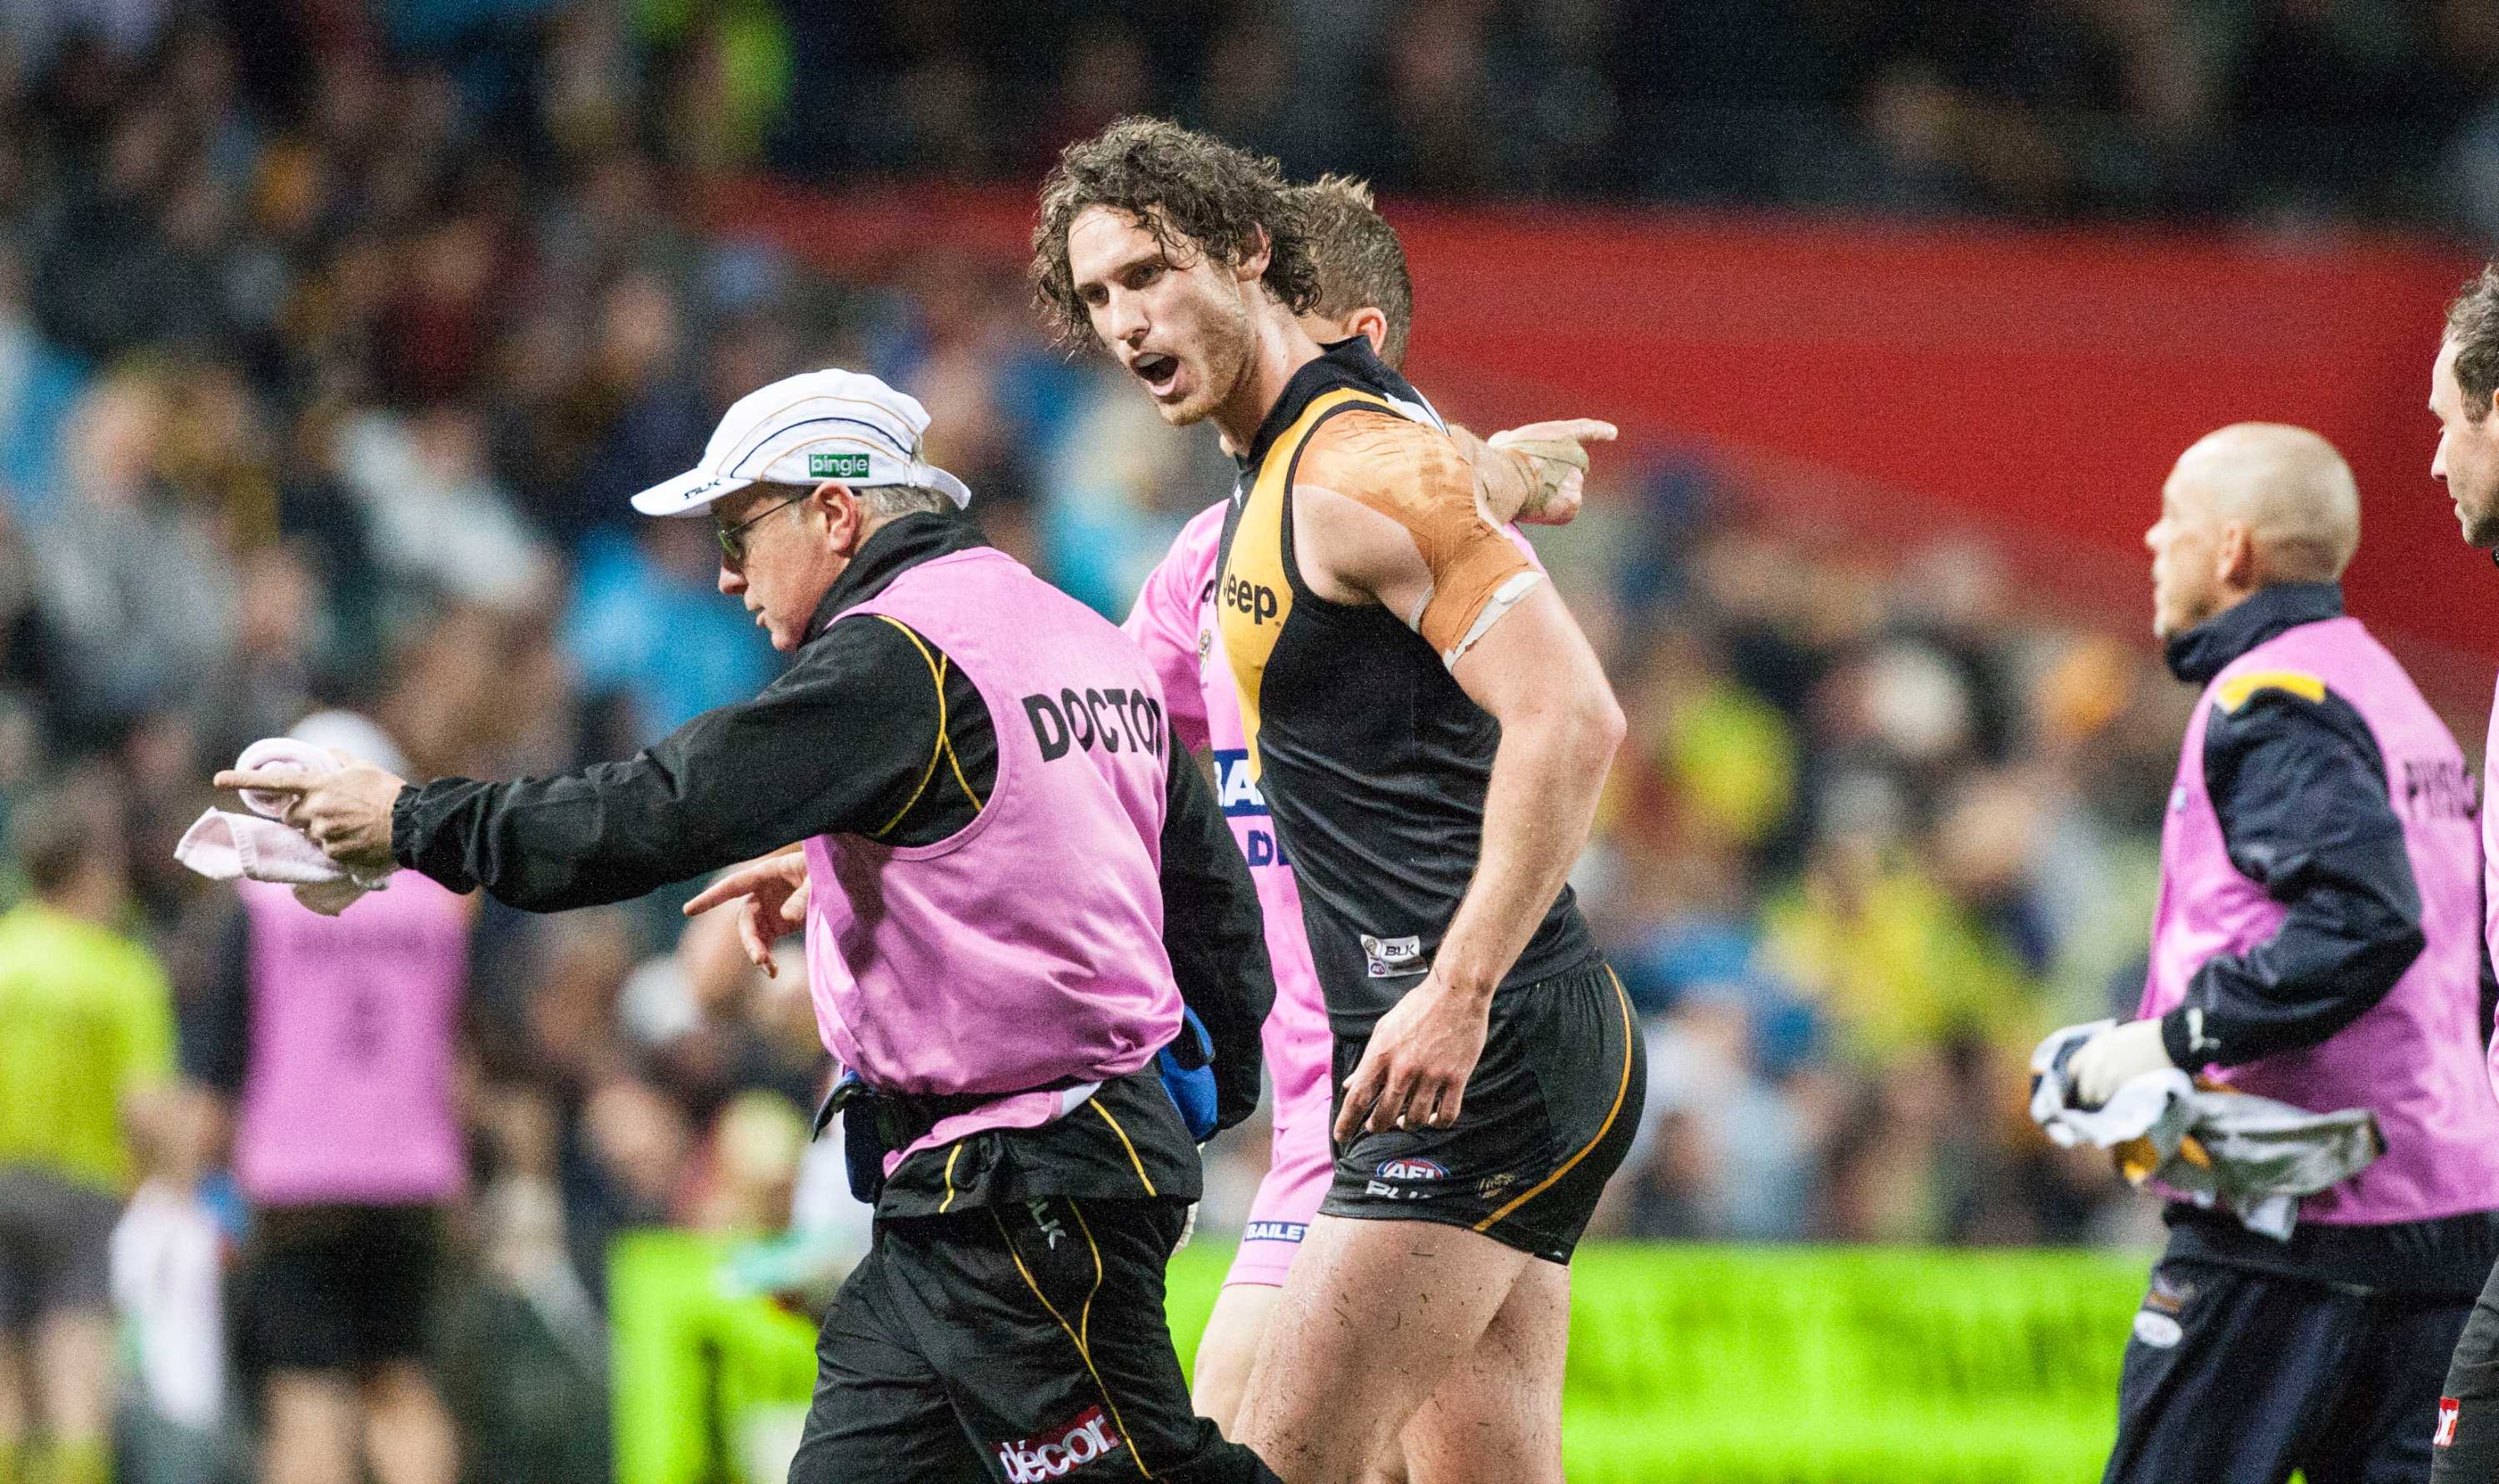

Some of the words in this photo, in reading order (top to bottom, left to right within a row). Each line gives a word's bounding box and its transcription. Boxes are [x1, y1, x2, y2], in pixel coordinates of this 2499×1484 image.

[811, 455, 868, 476] bingle
[1385, 944, 1414, 956] BLK
[1000, 1414, 1110, 1483] décor
